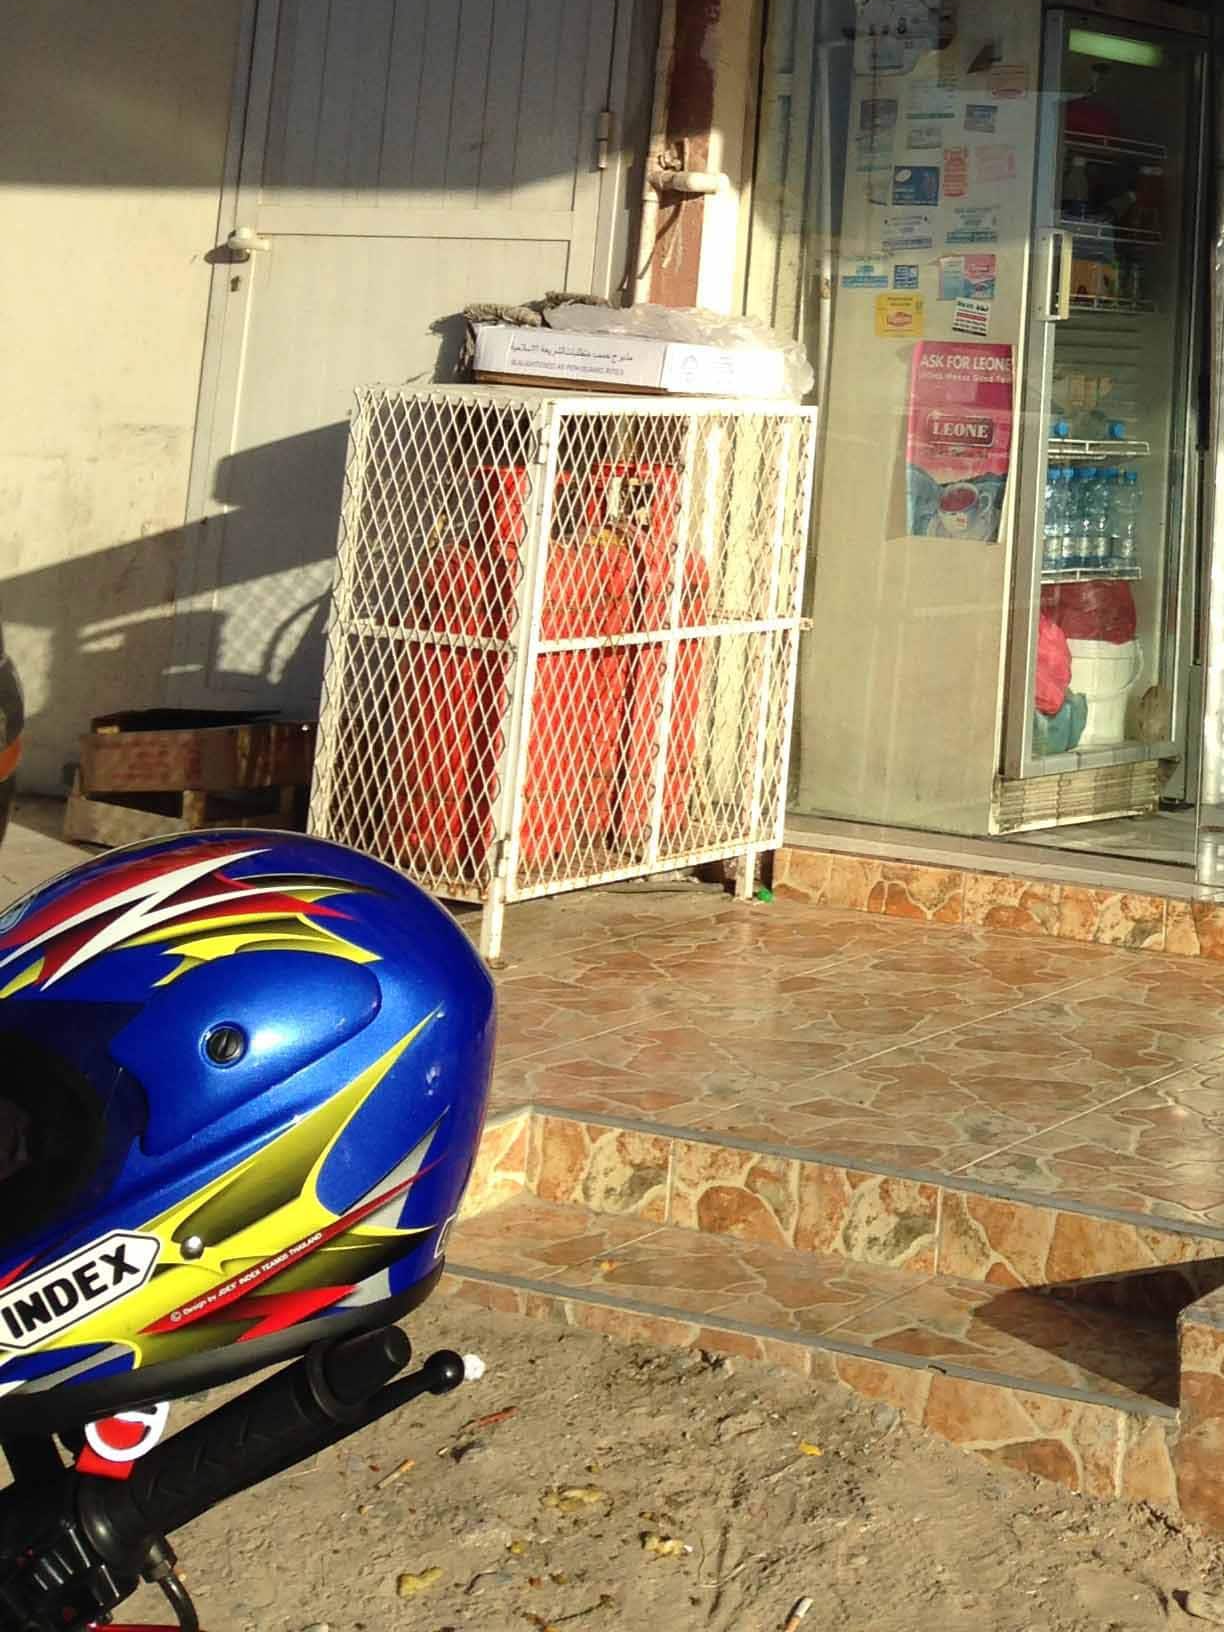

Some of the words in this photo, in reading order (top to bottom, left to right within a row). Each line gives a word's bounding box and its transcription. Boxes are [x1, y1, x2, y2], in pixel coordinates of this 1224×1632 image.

[920, 354, 945, 368] ASK
[946, 355, 970, 370] FOR
[973, 356, 1012, 372] LEONE
[932, 421, 989, 439] LEONE
[1, 1242, 141, 1340] INDEX
